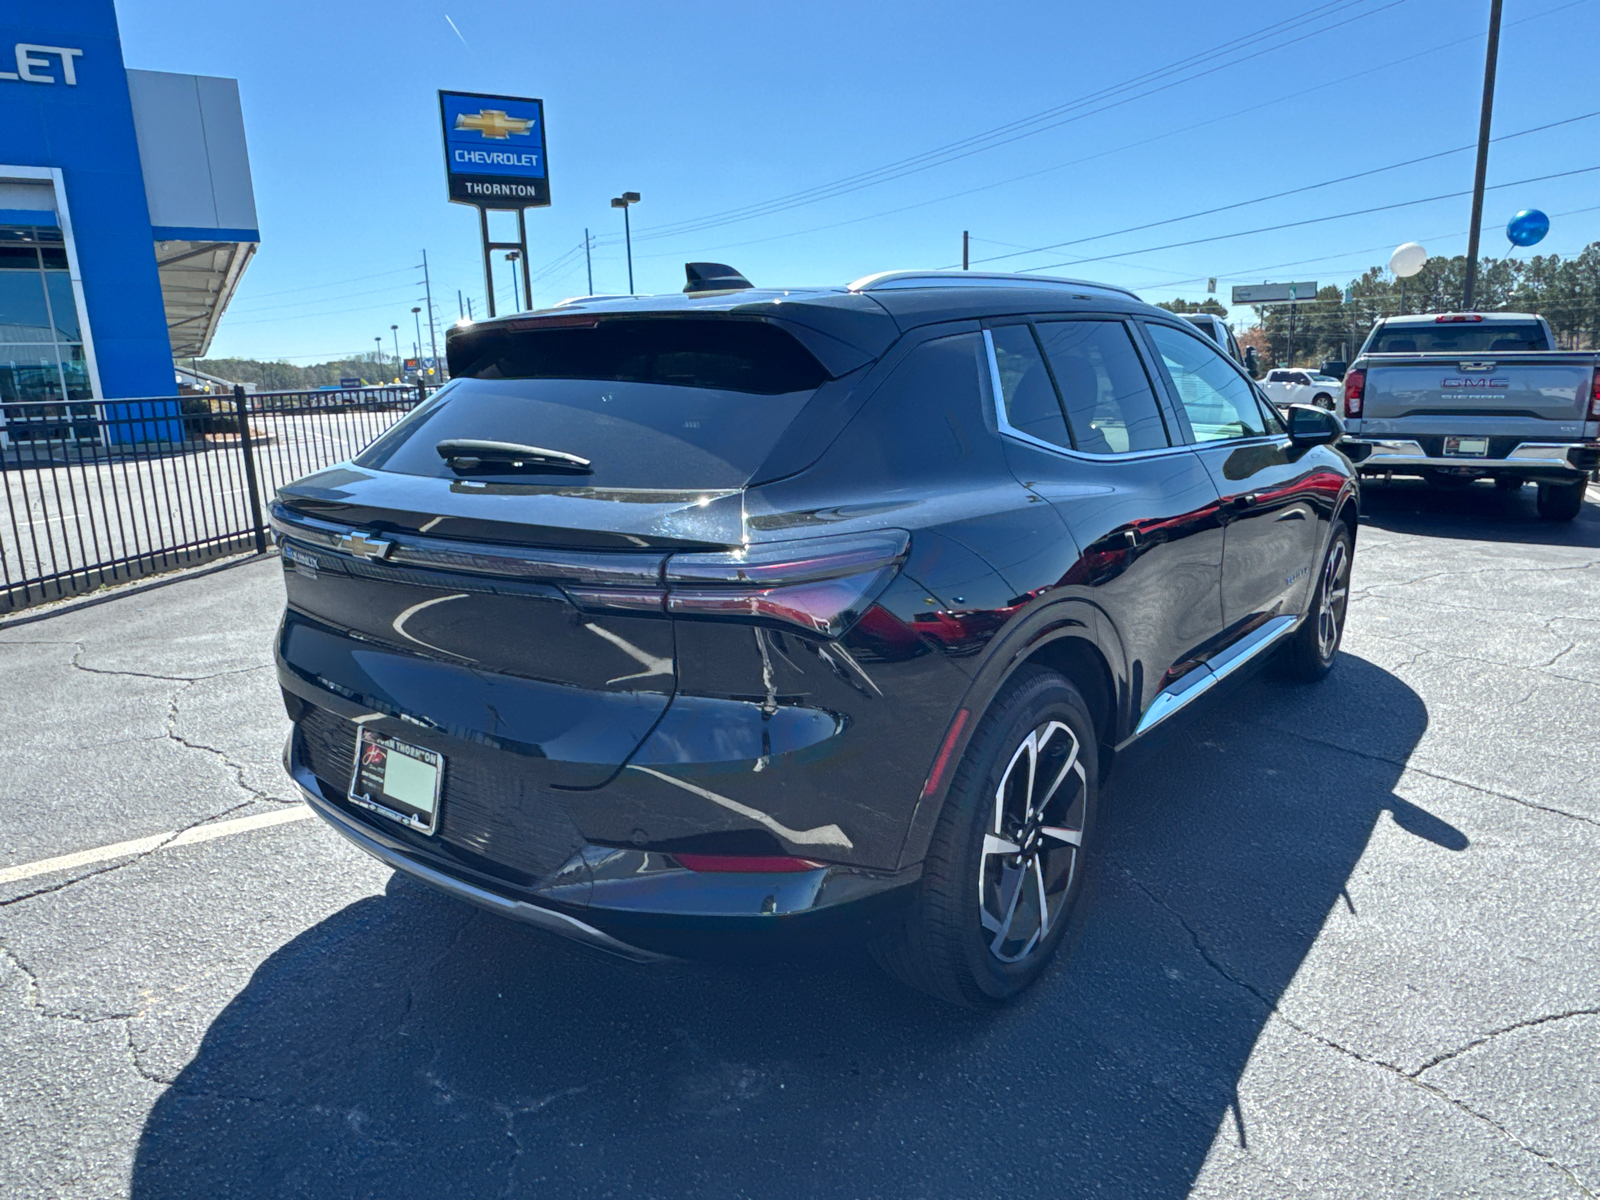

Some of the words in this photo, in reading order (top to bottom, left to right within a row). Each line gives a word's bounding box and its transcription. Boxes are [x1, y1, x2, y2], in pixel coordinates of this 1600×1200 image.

[455, 150, 538, 166] CHEVROLET
[465, 183, 535, 196] THORNTON
[1441, 378, 1509, 389] GMC
